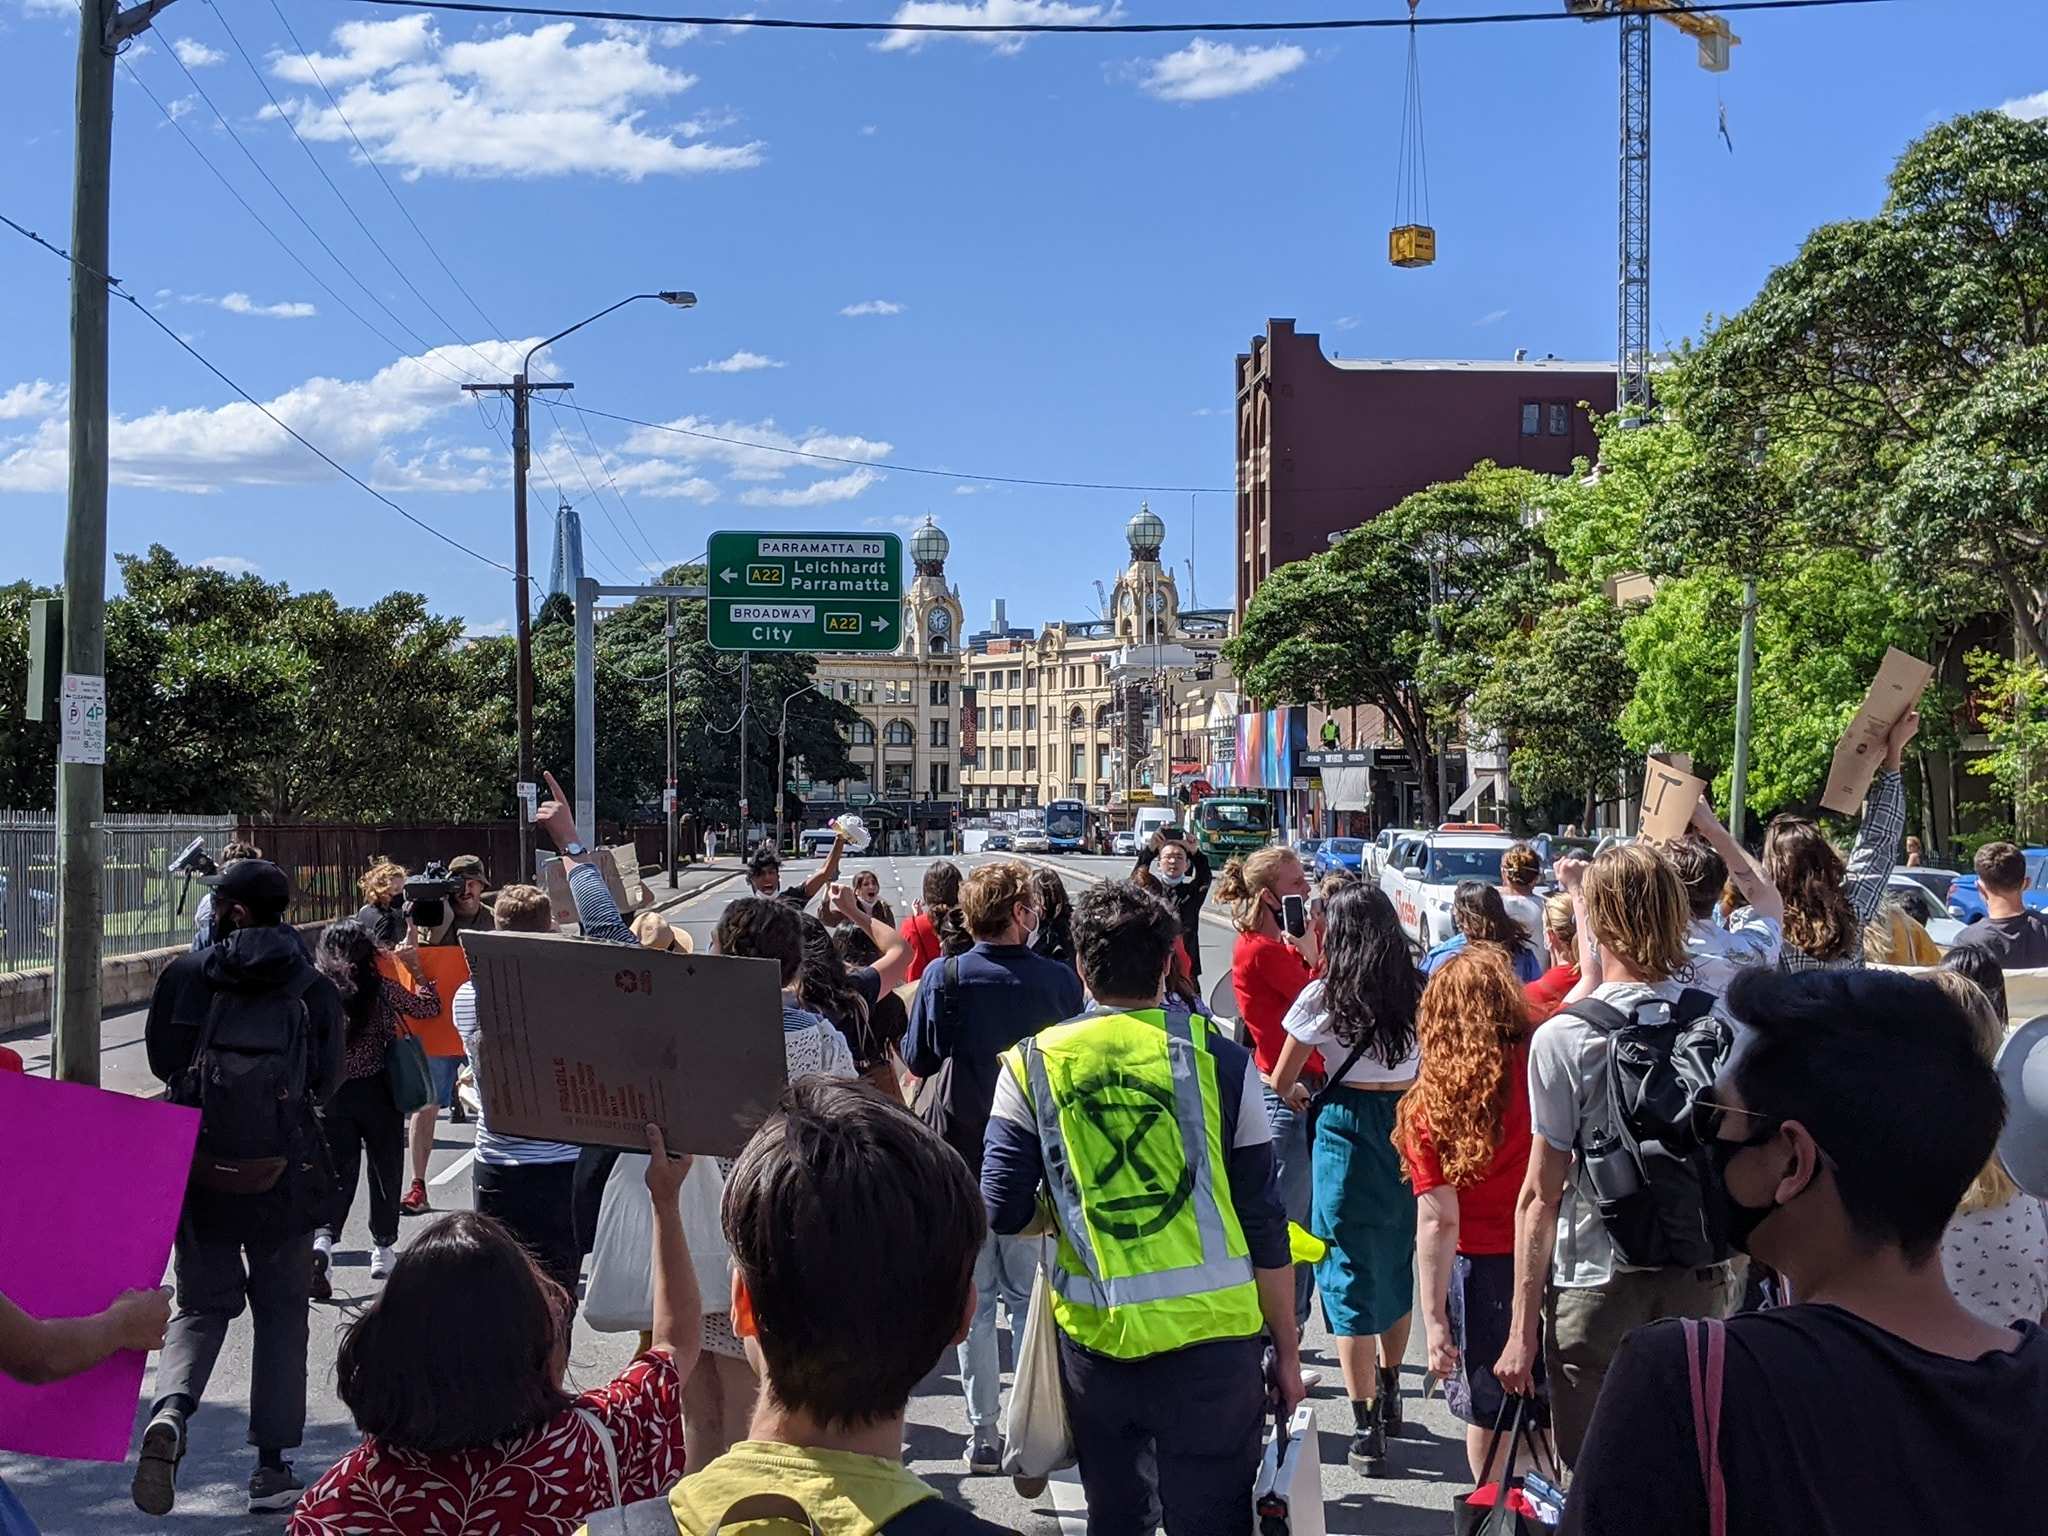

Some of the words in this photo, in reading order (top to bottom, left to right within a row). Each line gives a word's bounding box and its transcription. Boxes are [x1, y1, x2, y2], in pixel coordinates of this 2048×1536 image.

[762, 542, 855, 554] PARRAMATTA
[862, 543, 880, 554] RD
[794, 560, 886, 575] Leichhardt
[751, 569, 780, 582] A22
[791, 577, 889, 592] Parramatta
[734, 608, 811, 620] BROADWAY
[828, 618, 857, 631] A22
[752, 626, 793, 644] City
[1194, 651, 1218, 660] Lodge
[86, 707, 104, 720] 4P
